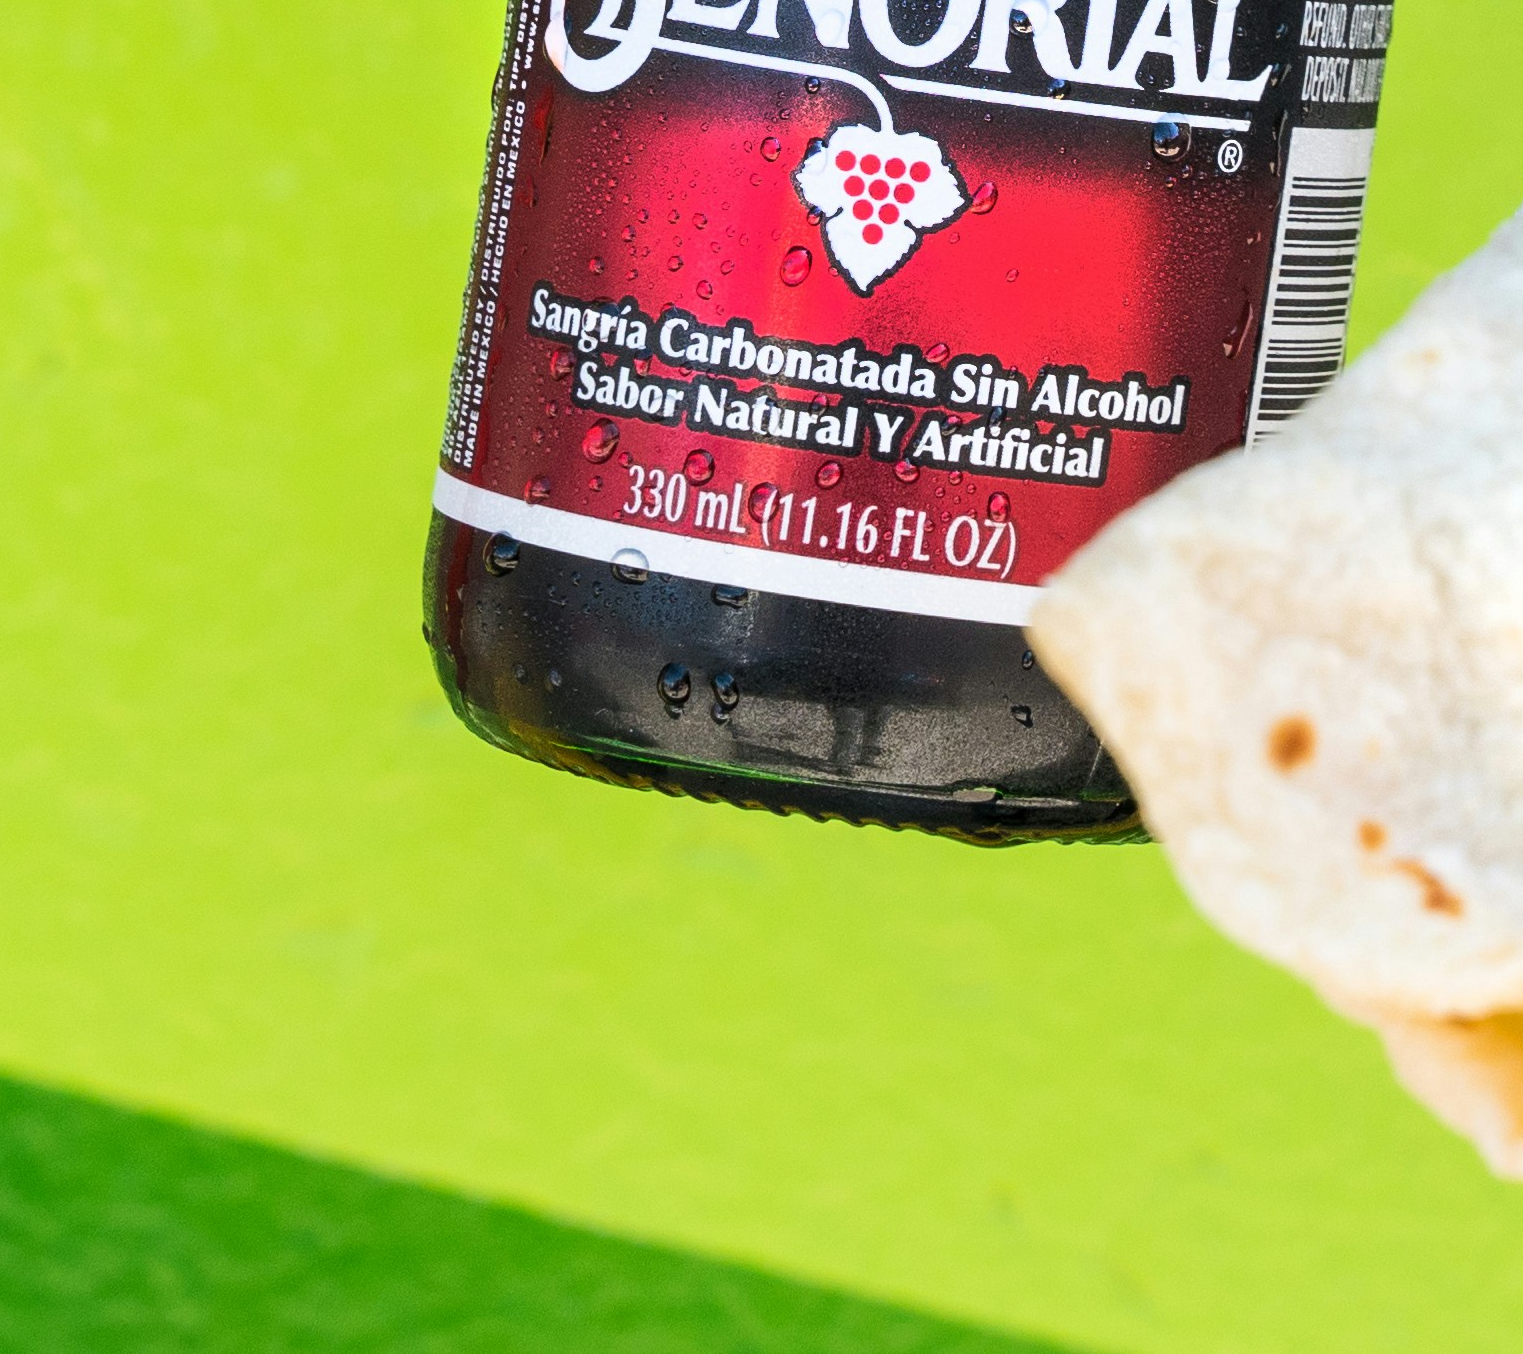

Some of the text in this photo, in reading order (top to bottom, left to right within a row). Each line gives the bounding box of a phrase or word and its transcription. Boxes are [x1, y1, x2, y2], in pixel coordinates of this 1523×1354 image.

[1301, 55, 1350, 102] DEPOSIT
[505, 100, 526, 179] MEXICO
[500, 184, 514, 210] EN
[453, 329, 480, 464] DISTRIBUTED
[474, 297, 484, 325] BY
[480, 151, 507, 282] DISTRIBUIDO
[508, 47, 522, 91] TIPP
[490, 214, 509, 283] HECHO
[477, 300, 496, 378] MEXICO
[531, 288, 647, 354] Sangría
[659, 318, 937, 400] Carbonatada
[950, 363, 1018, 410] Sin
[1029, 381, 1188, 427] Alcohol
[471, 382, 484, 406] IN
[576, 362, 1105, 480] Sabor Natural Y Artificial
[462, 409, 480, 468] MADE
[622, 465, 1019, 581] 330 mL (11.16 FL OZ)
